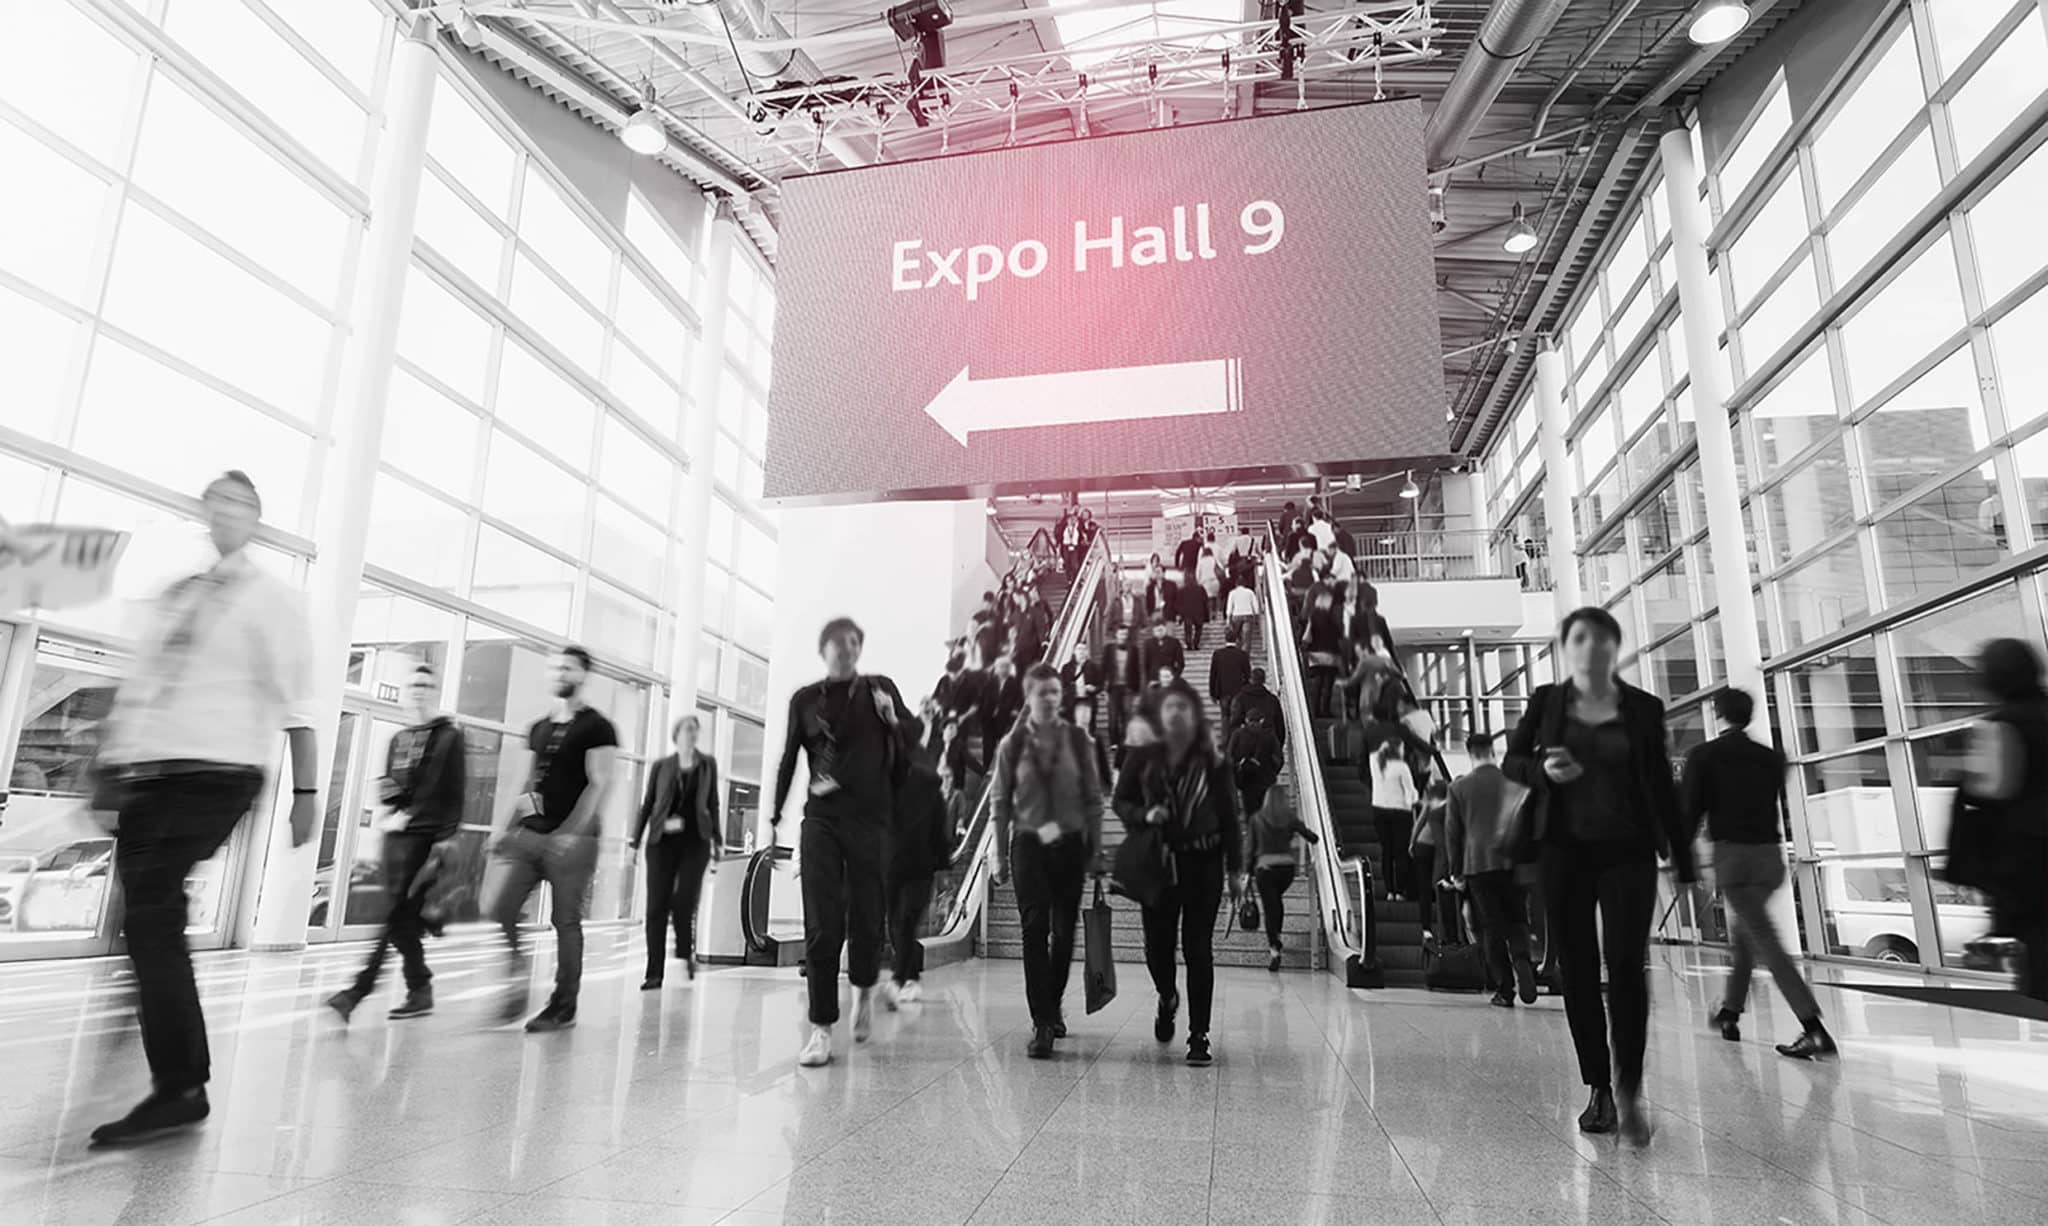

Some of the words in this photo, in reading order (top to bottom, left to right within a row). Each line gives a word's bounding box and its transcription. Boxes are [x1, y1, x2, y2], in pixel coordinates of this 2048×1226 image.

[890, 238, 1049, 302] Expo
[1074, 202, 1217, 272] Hall
[1240, 199, 1286, 256] 9
